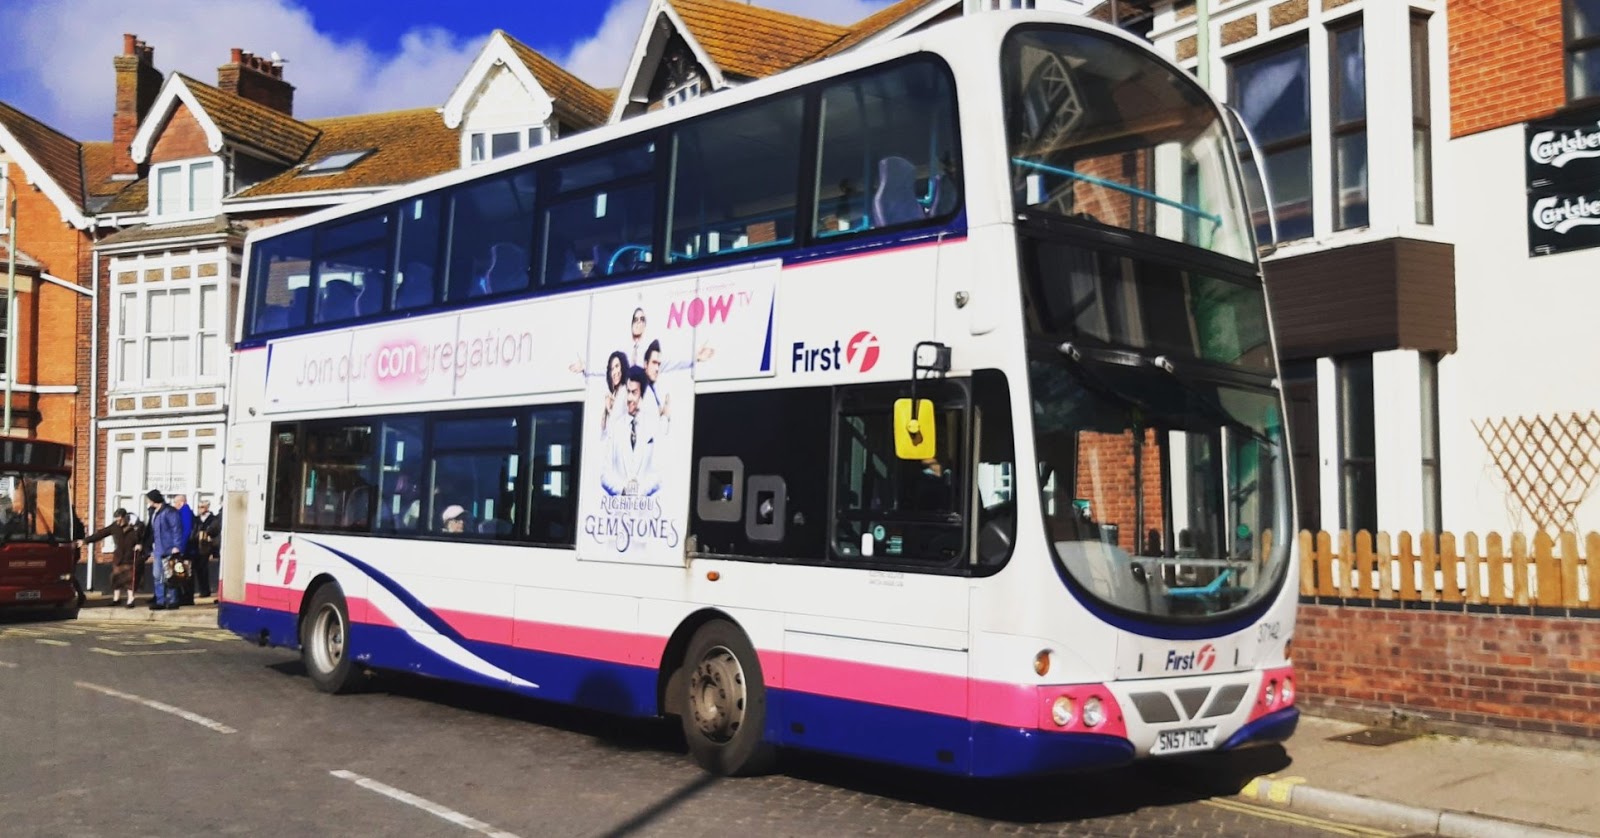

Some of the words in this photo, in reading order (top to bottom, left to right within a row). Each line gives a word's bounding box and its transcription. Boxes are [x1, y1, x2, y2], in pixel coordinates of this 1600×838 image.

[1530, 130, 1600, 165] Carlsbe
[667, 293, 734, 330] NOW
[738, 290, 754, 307] TV
[296, 352, 334, 386] Join
[338, 351, 372, 381] our
[377, 328, 533, 385] congregation
[792, 340, 841, 373] First
[600, 495, 662, 520] RIGHTEOUS
[585, 512, 679, 553] GEMSTONES
[1165, 649, 1195, 671] First
[1159, 731, 1186, 750] SN57
